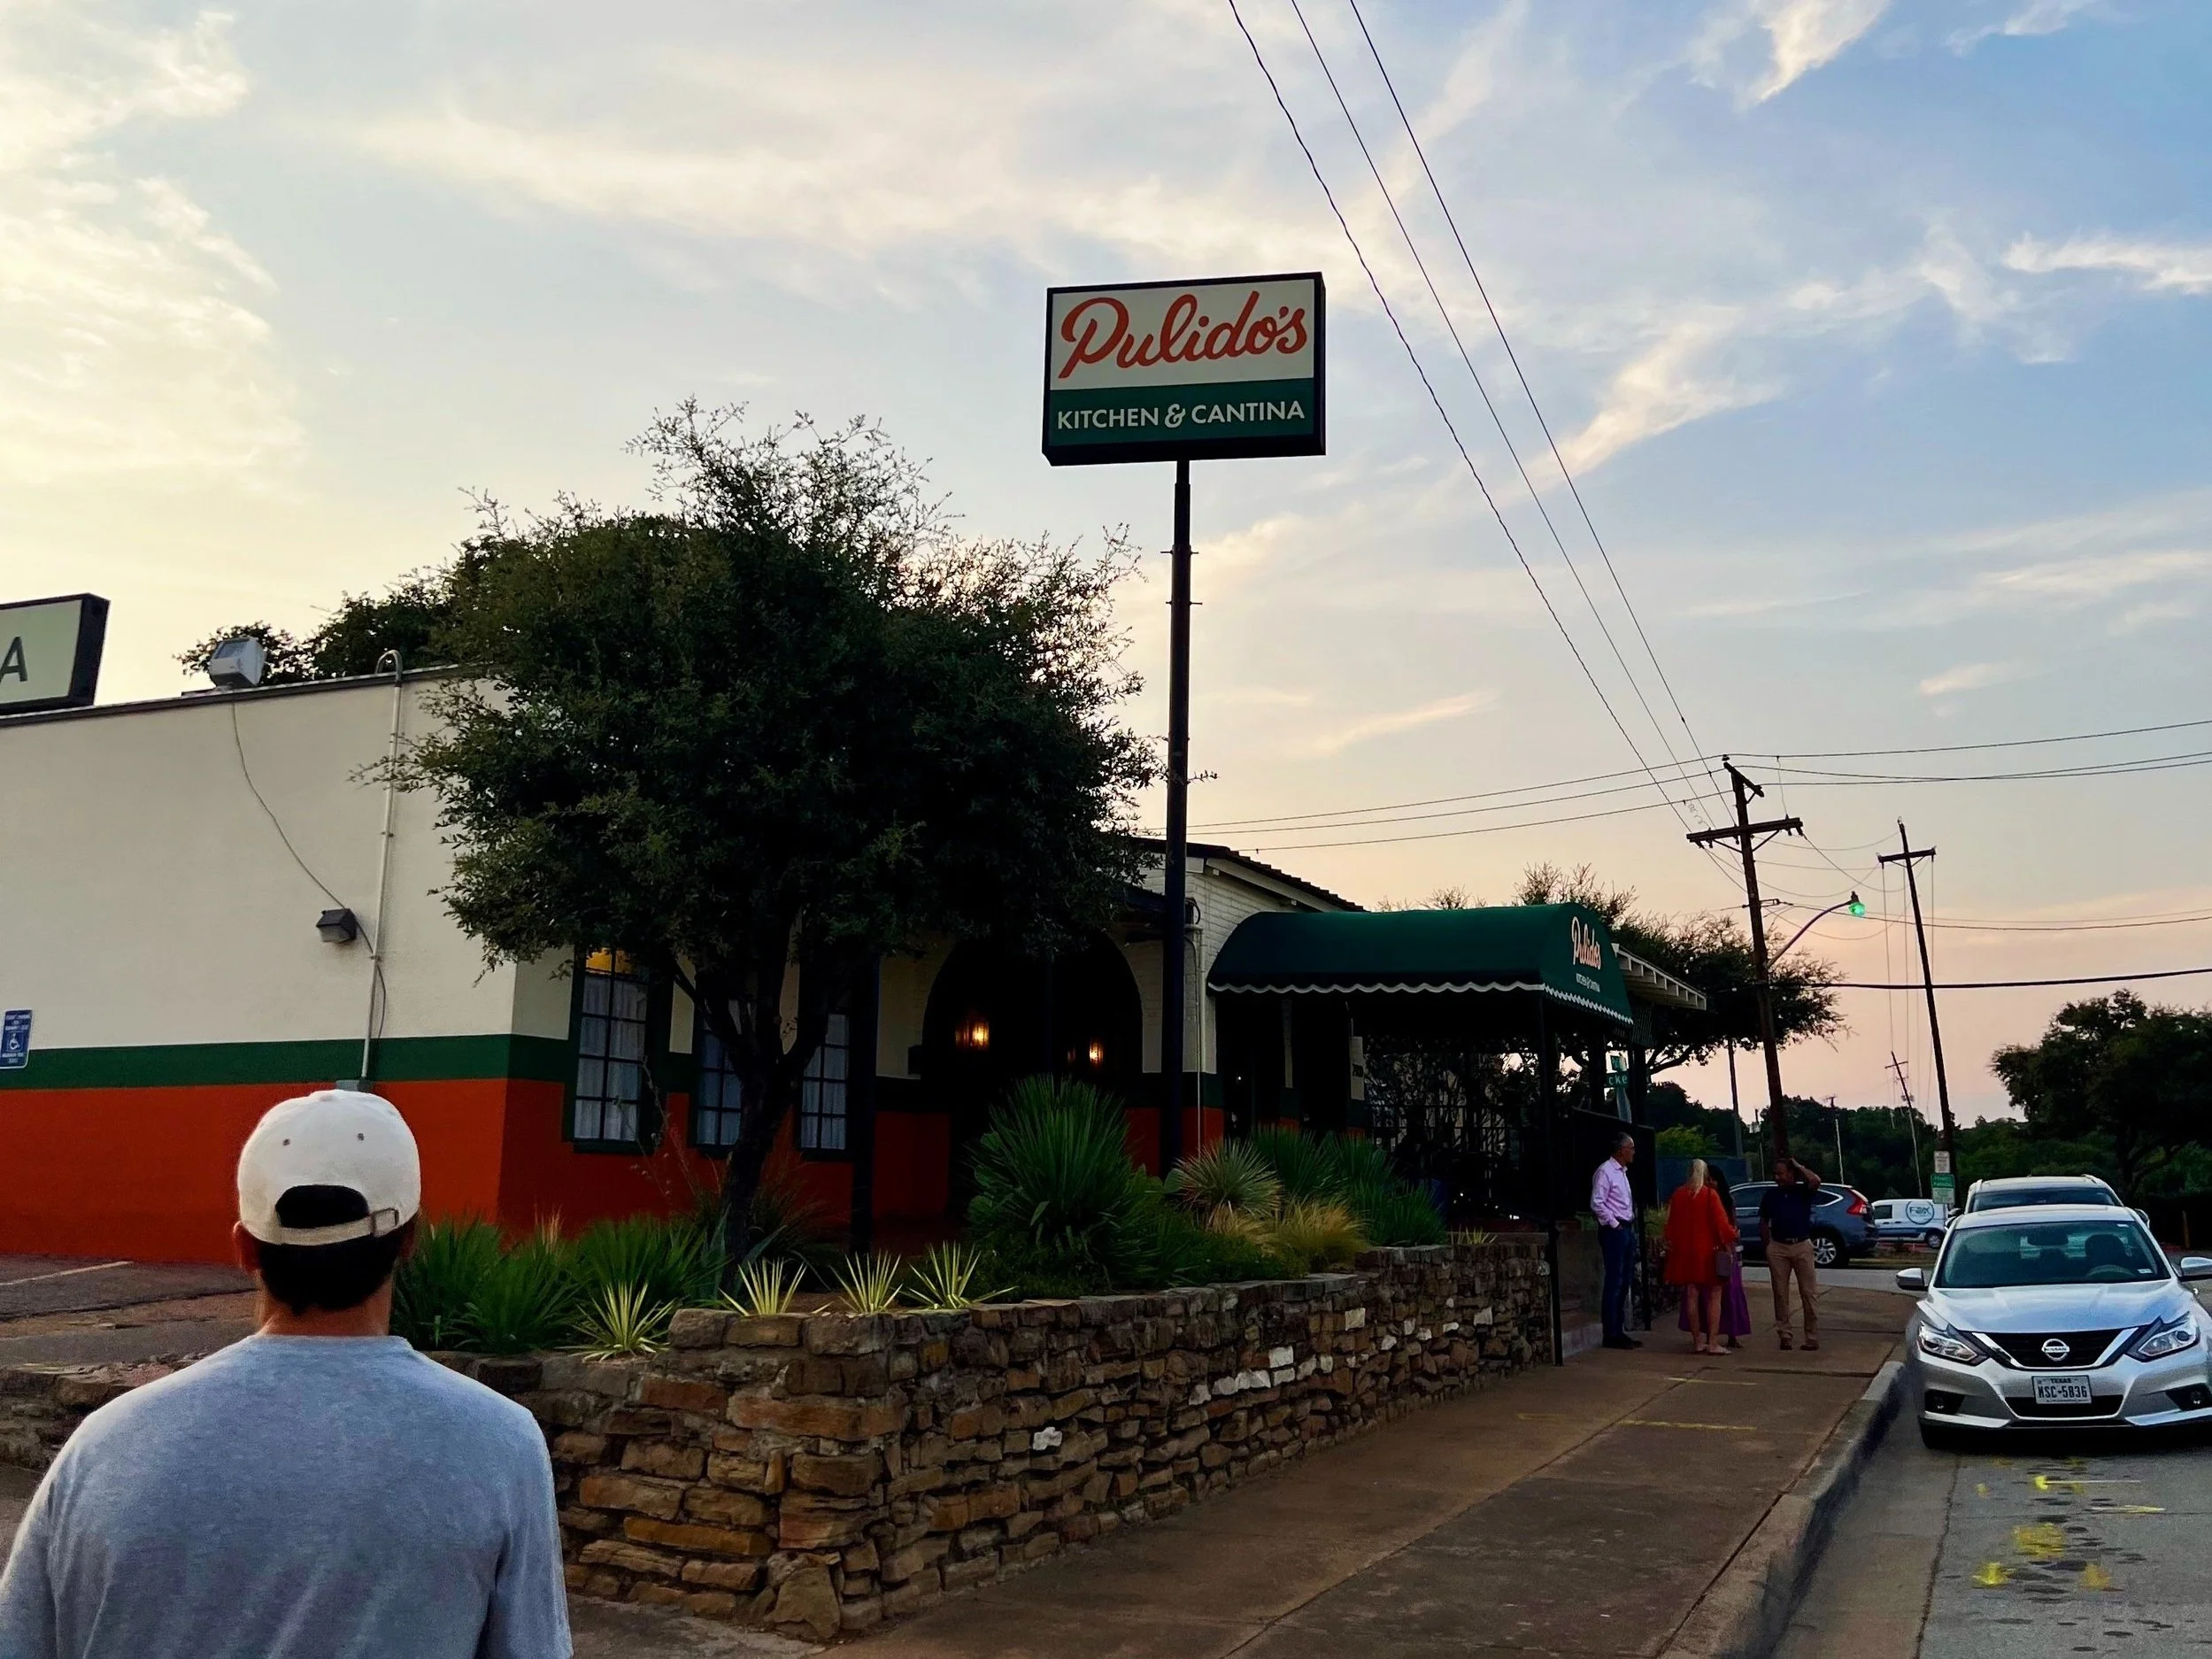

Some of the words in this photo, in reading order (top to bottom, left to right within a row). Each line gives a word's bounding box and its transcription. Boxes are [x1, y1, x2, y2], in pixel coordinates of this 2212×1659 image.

[1058, 290, 1308, 379] Pulido's
[1058, 407, 1159, 429] KITCHEN
[1164, 404, 1186, 428] &
[1191, 400, 1306, 424] CANTINA
